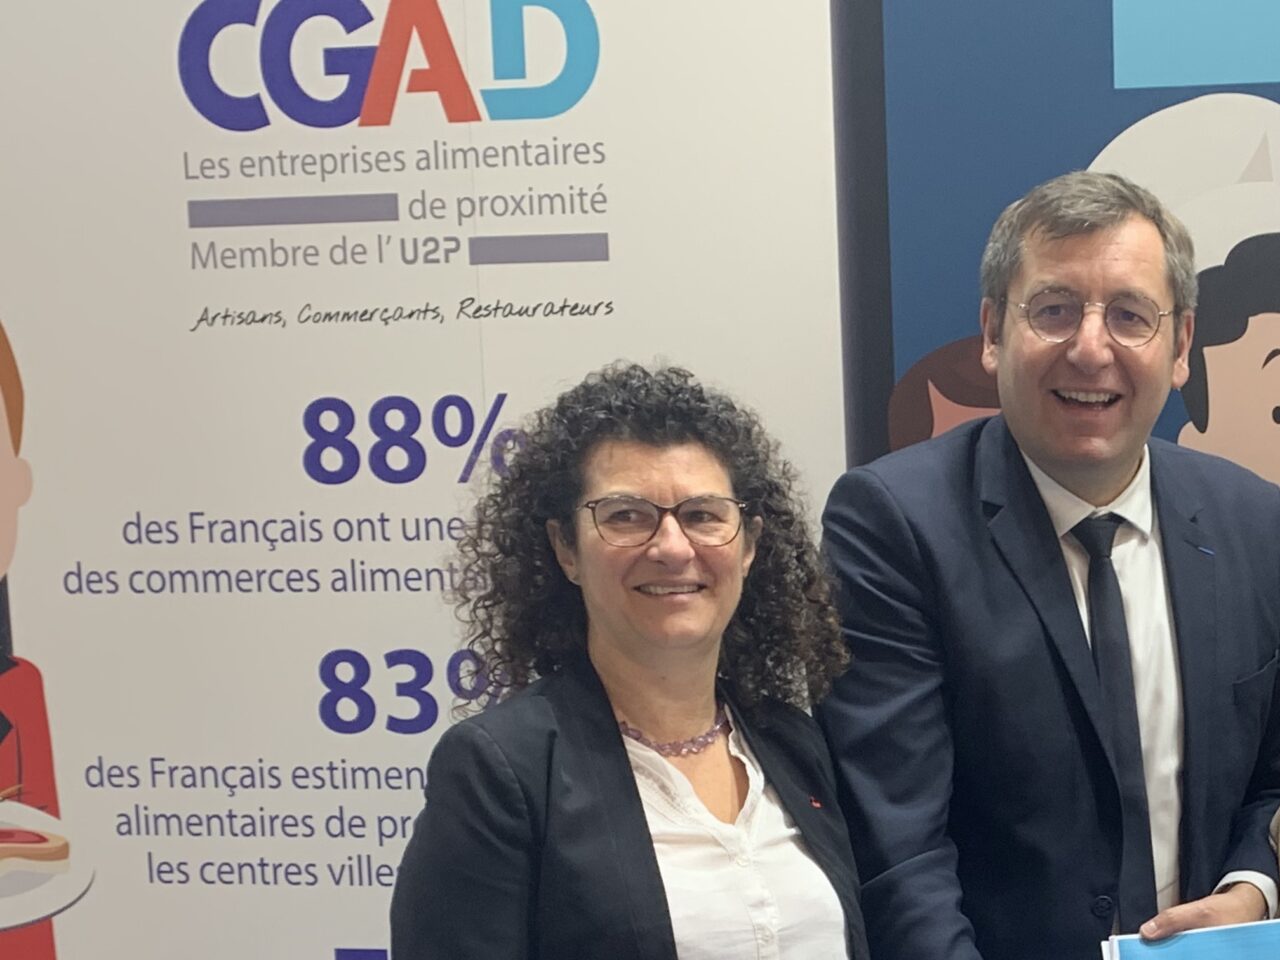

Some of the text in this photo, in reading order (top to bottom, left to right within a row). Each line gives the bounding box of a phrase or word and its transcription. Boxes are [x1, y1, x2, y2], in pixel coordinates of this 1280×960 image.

[178, 0, 600, 132] CGAD
[183, 137, 606, 182] Les entreprises alimentaires
[408, 183, 608, 226] de proximité
[190, 240, 320, 270] Membre
[329, 236, 367, 265] de
[400, 237, 461, 265] U2P
[190, 297, 615, 332] Artisans, Commerçants, Restaurateurs
[302, 393, 527, 486] 88%
[122, 512, 179, 544] des
[189, 511, 322, 551] Français
[333, 512, 391, 542] ont
[401, 515, 466, 541] une
[62, 560, 119, 594] des
[128, 567, 321, 594] commerces
[84, 756, 426, 797] des Français estimen
[115, 804, 412, 847] alimentaires de pr
[148, 851, 399, 887] les centres ville
